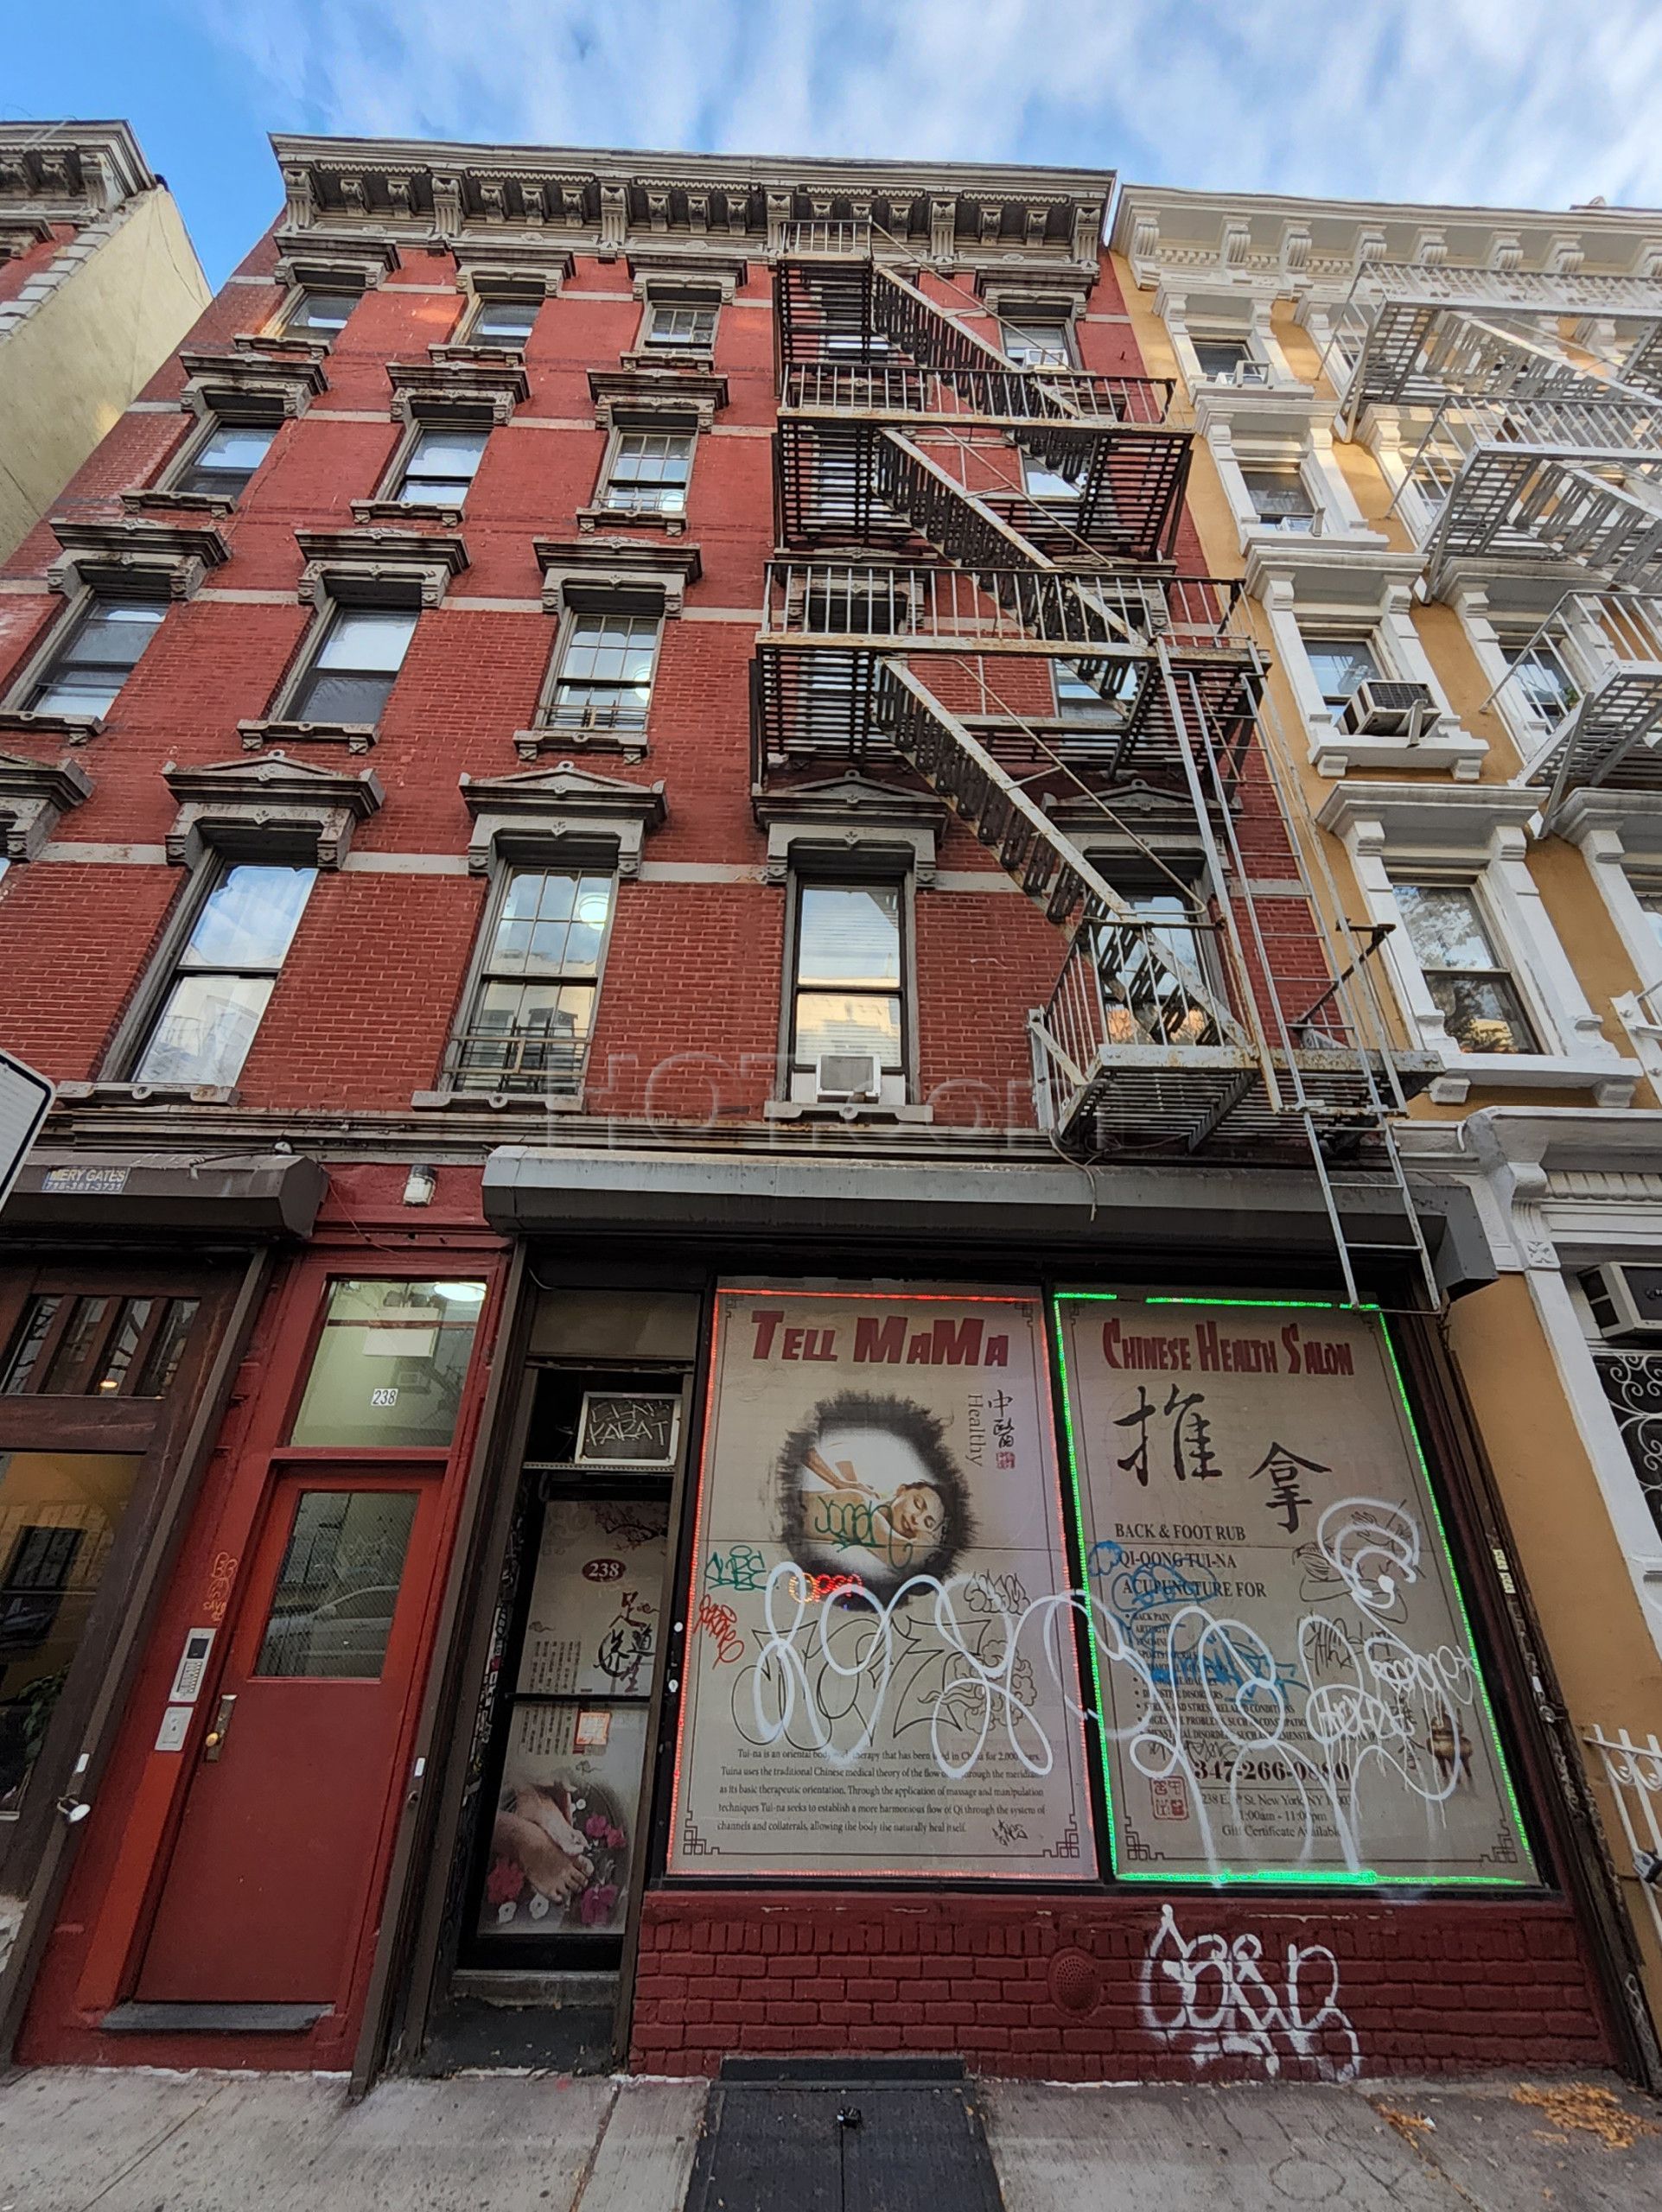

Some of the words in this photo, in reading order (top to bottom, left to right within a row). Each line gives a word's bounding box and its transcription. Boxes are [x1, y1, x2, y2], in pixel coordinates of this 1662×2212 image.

[86, 1169, 126, 1182] GATES
[373, 1389, 397, 1405] 238
[965, 1393, 987, 1467] Healthy
[1115, 1522, 1156, 1539] BACK
[1158, 1523, 1170, 1539] &
[1172, 1524, 1213, 1541] FOOT
[1216, 1526, 1246, 1541] RUB
[589, 1562, 620, 1578] 238
[1122, 1580, 1233, 1598] ACUPUNCTURE
[1236, 1581, 1268, 1599] FOR
[1133, 1612, 1153, 1621] ACK
[763, 1749, 770, 1758] is
[812, 1750, 829, 1760] bod
[853, 1751, 880, 1762] erapy
[882, 1750, 896, 1760] that
[898, 1750, 911, 1760] has
[913, 1750, 931, 1760] been
[961, 1751, 984, 1761] Cha
[721, 1765, 742, 1776] Tuina
[761, 1765, 773, 1776] the
[774, 1766, 812, 1777] traditional
[813, 1766, 844, 1777] Chinese
[845, 1767, 875, 1777] medical
[876, 1767, 900, 1779] theory
[901, 1767, 910, 1778] of
[911, 1768, 923, 1778] the
[924, 1768, 940, 1778] flow
[964, 1770, 991, 1781] rough
[992, 1769, 1004, 1778] the
[719, 1785, 728, 1794] as
[729, 1784, 737, 1794] its
[739, 1783, 757, 1794] basic
[759, 1783, 801, 1797] therapeutic
[847, 1784, 880, 1798] Through
[882, 1785, 894, 1796] the
[895, 1786, 935, 1798] application
[937, 1786, 946, 1796] of
[946, 1789, 977, 1799] massage
[977, 1787, 992, 1796] and
[994, 1787, 1044, 1798] manipulation
[1258, 1795, 1280, 1806] New
[718, 1802, 760, 1815] techniques
[761, 1802, 786, 1813] Tui-na
[786, 1802, 807, 1813] seeks
[808, 1803, 817, 1813] to
[818, 1802, 850, 1814] establish
[857, 1805, 878, 1814] more
[879, 1803, 925, 1815] harmonious
[927, 1803, 942, 1815] flow
[944, 1804, 952, 1815] of
[964, 1804, 995, 1816] through
[997, 1804, 1009, 1815] the
[1010, 1806, 1036, 1817] system
[1037, 1804, 1046, 1815] of
[717, 1820, 751, 1831] channels
[752, 1821, 767, 1831] and
[810, 1820, 844, 1834] allowing
[844, 1821, 857, 1832] the
[858, 1821, 877, 1834] body
[893, 1821, 927, 1835] naturally
[928, 1821, 945, 1833] heal
[1245, 1825, 1296, 1838] Certificate
